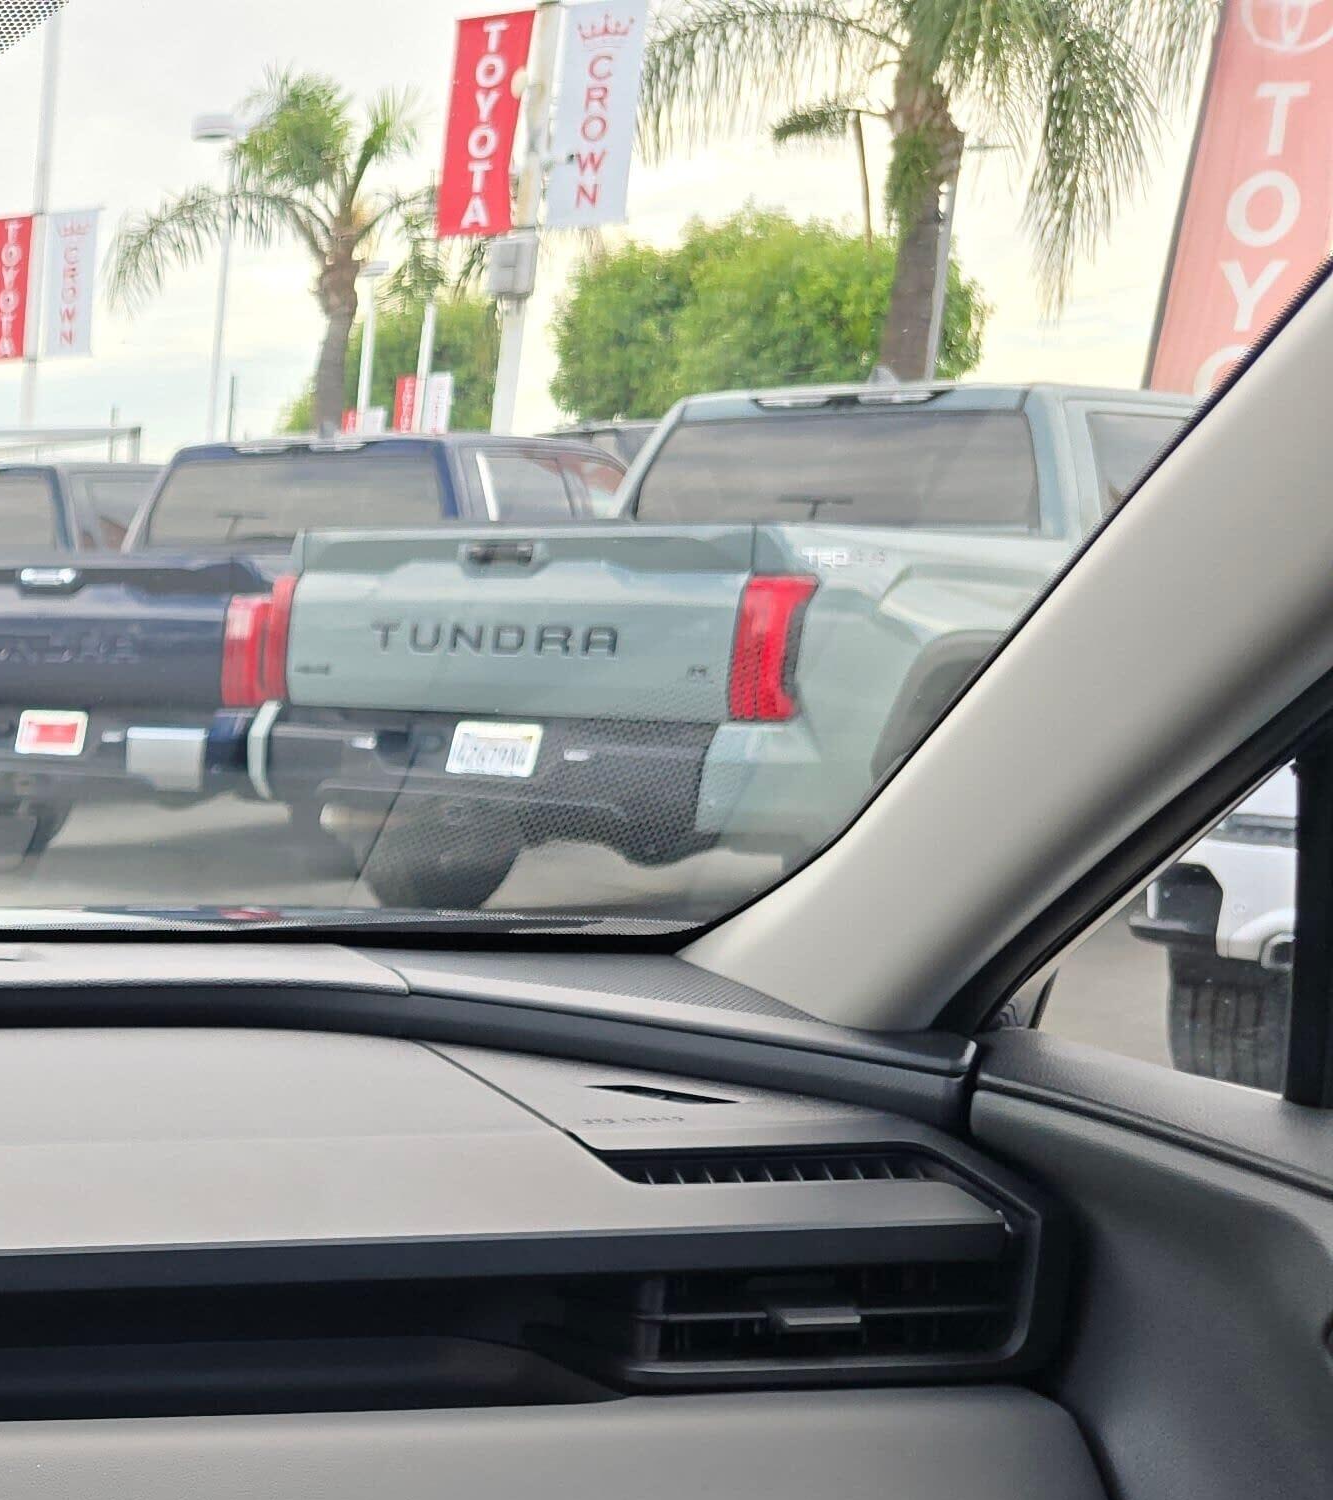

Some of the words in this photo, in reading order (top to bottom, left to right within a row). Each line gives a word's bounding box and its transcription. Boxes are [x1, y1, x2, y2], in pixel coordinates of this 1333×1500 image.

[460, 18, 511, 229] TOYOTA
[576, 55, 614, 208] CROWN
[370, 618, 621, 660] TUNDRA
